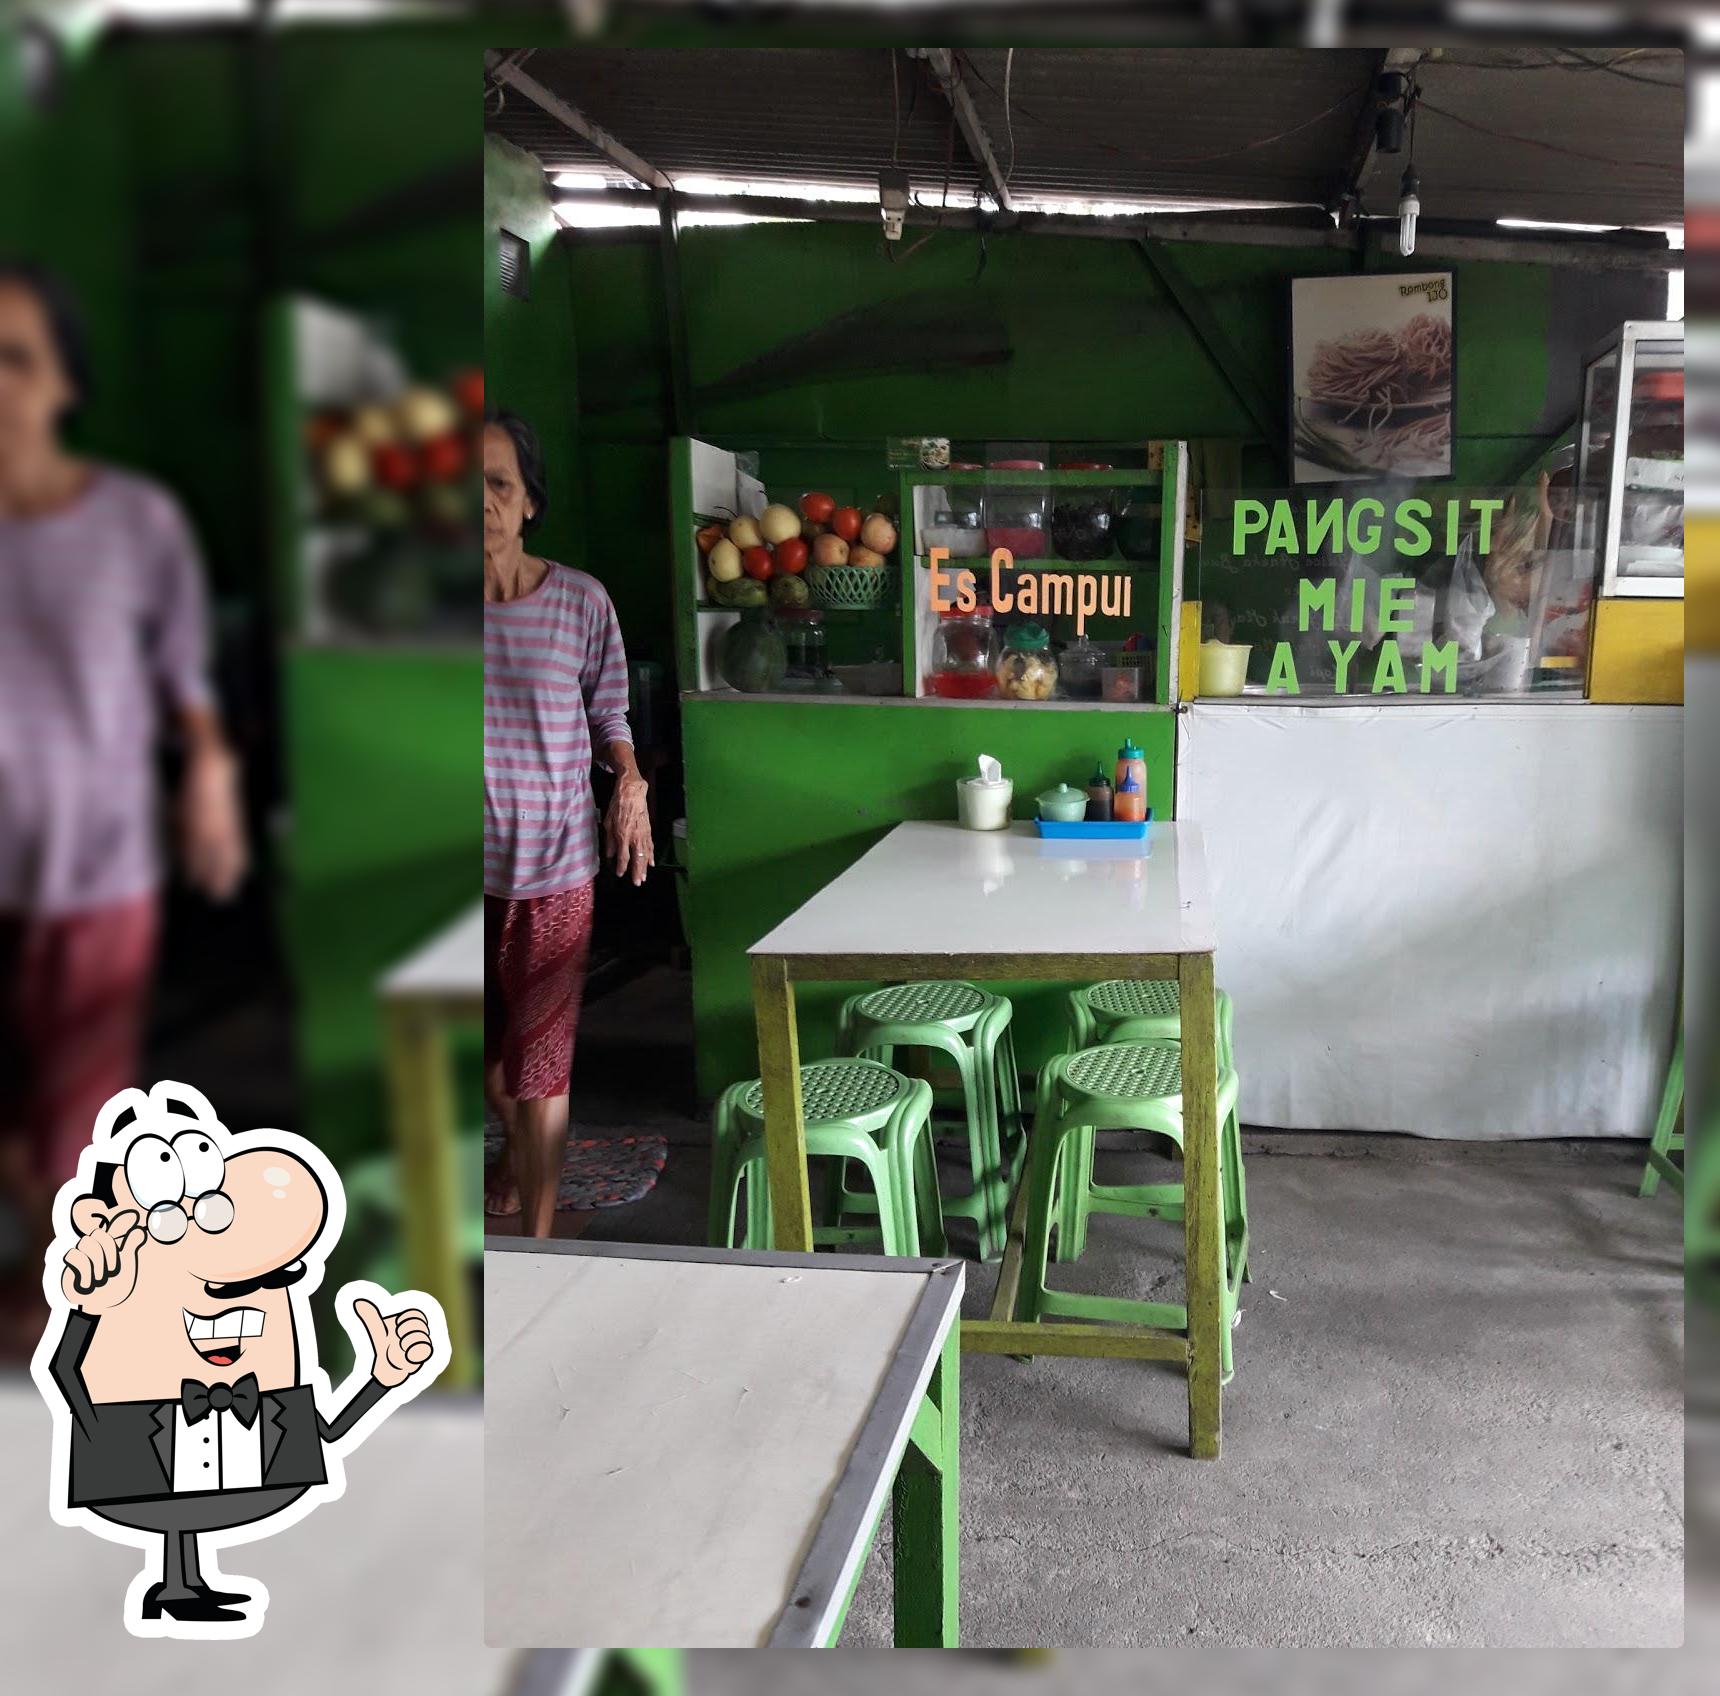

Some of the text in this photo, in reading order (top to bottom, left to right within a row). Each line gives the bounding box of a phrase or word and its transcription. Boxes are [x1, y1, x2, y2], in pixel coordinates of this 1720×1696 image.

[1233, 498, 1504, 556] PANGSIT
[929, 547, 977, 613] Es
[1298, 578, 1417, 633] MIE
